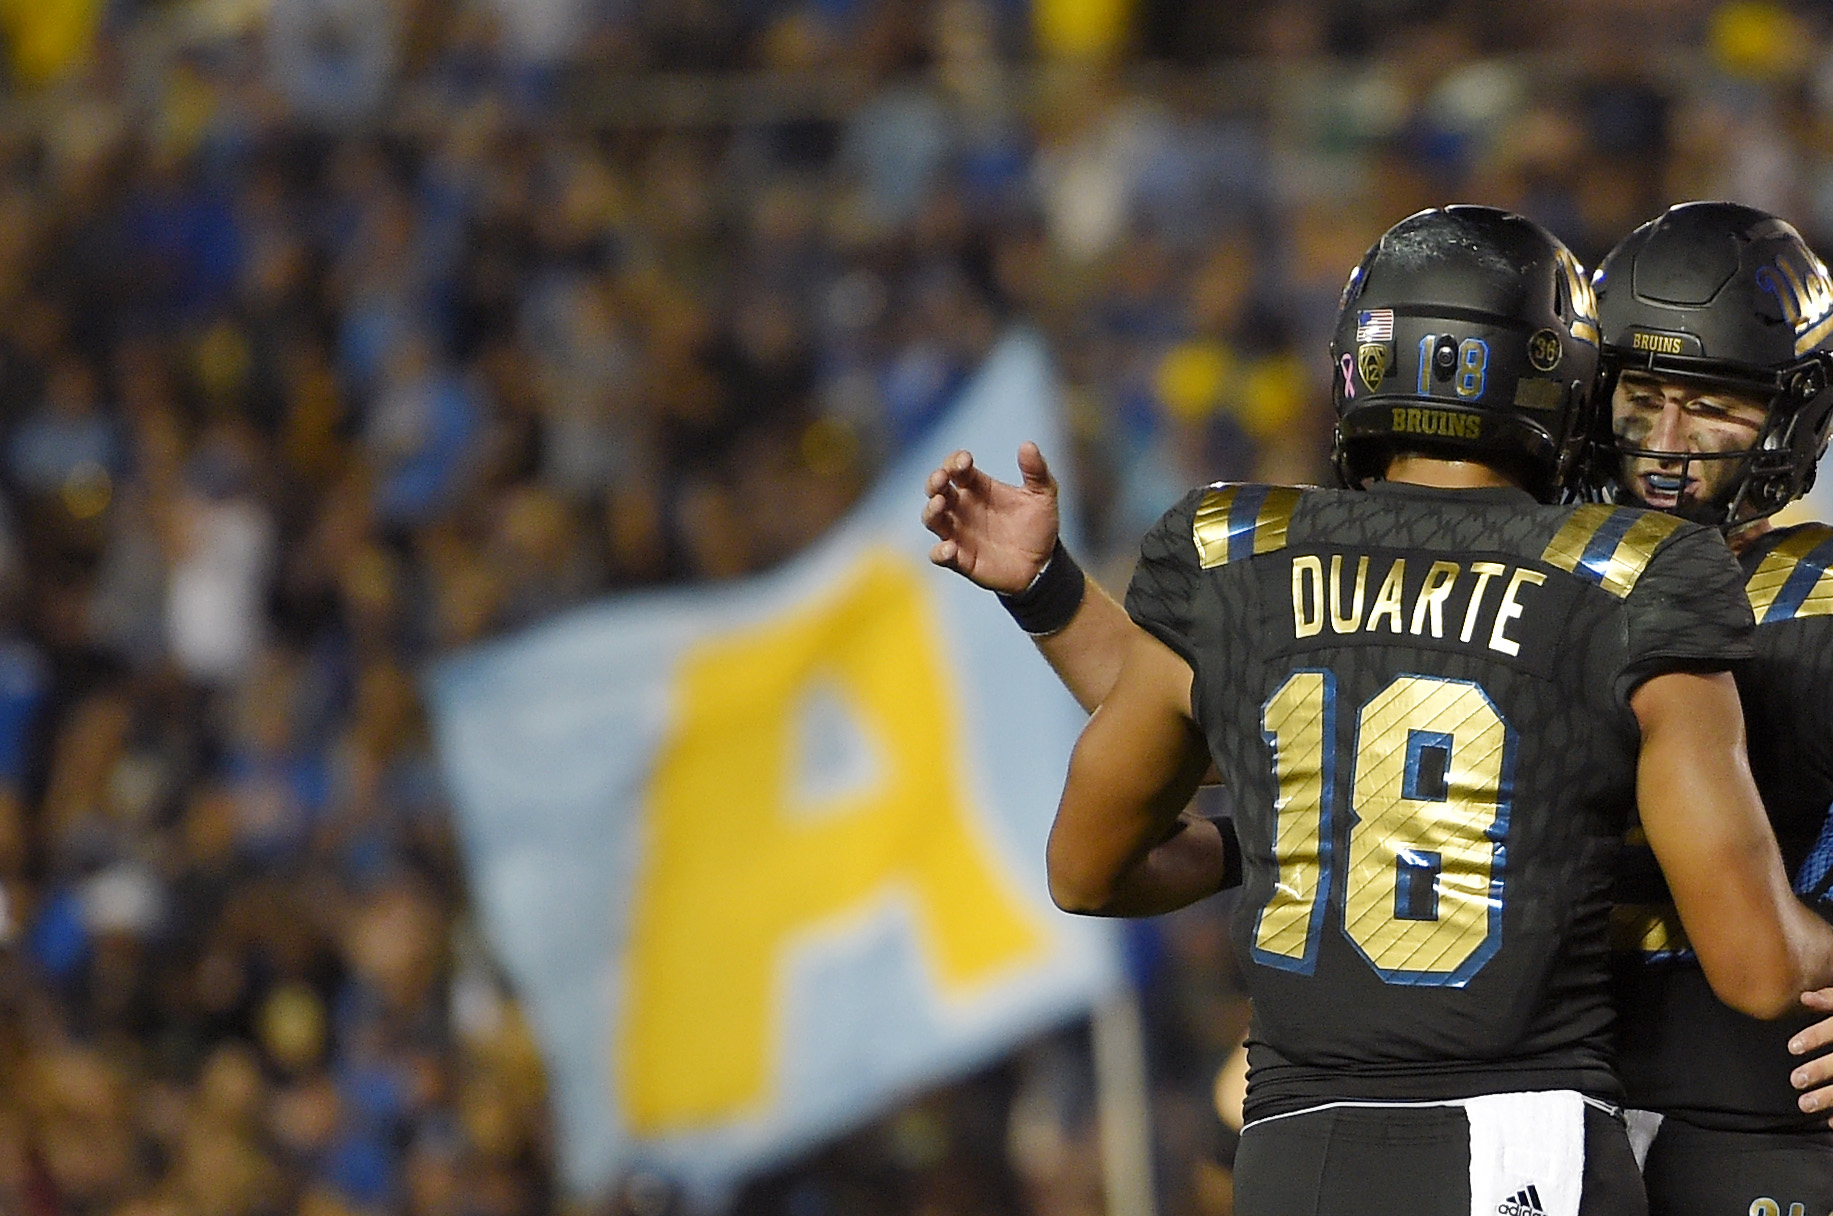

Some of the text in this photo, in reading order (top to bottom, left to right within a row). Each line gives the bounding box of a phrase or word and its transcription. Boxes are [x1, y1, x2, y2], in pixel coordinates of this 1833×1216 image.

[1417, 334, 1489, 401] 18
[1633, 333, 1682, 354] BRUINS
[1392, 408, 1482, 439] BRUINS
[1292, 555, 1548, 657] DUARTE
[619, 541, 1055, 1138] A
[1250, 667, 1519, 989] 18
